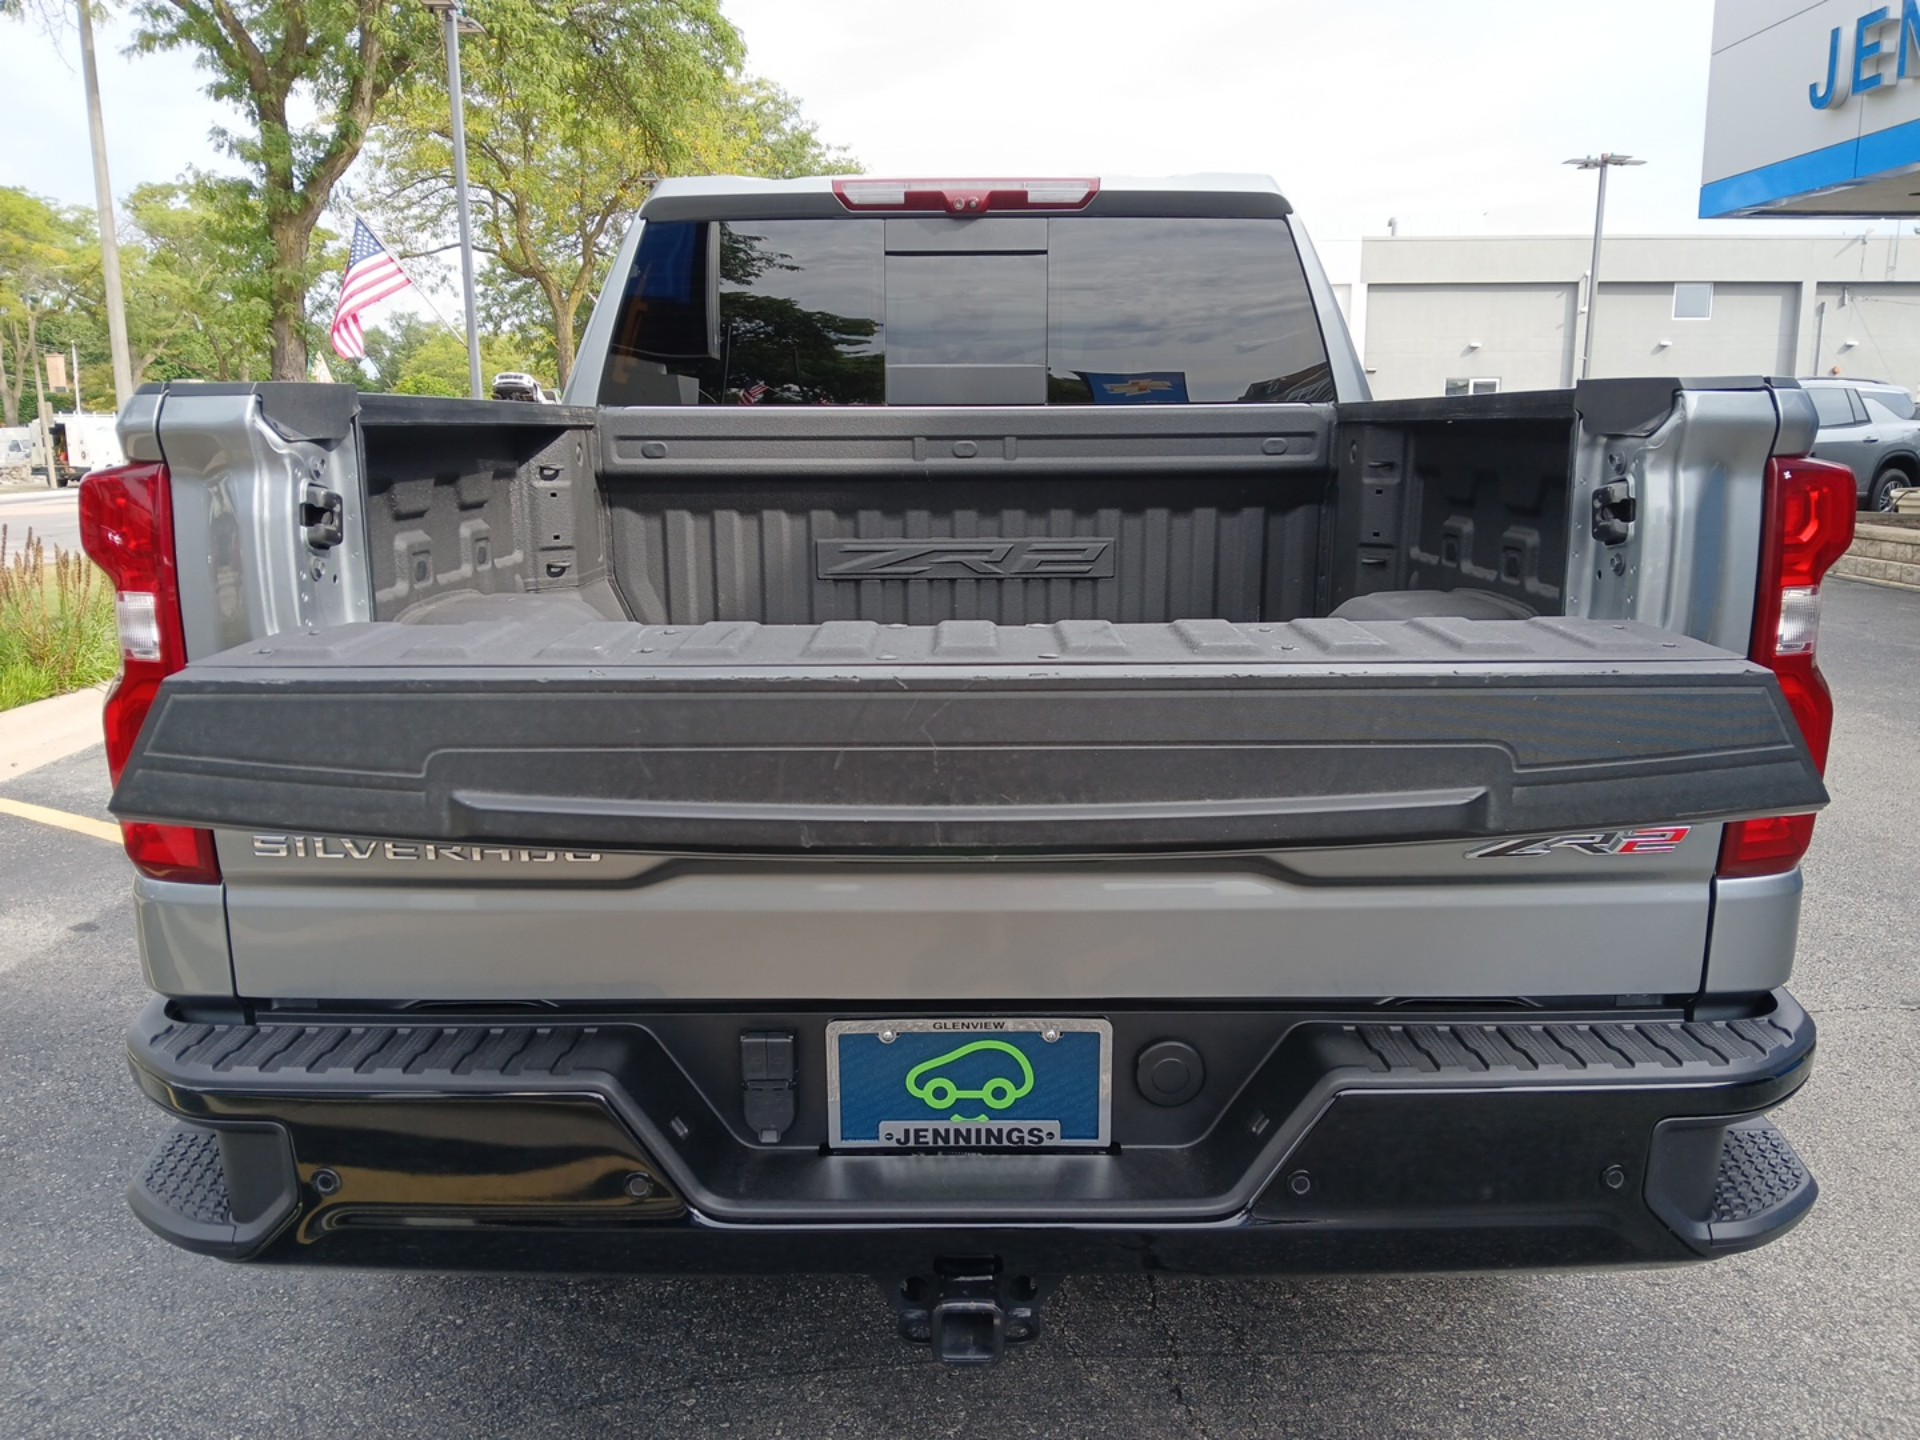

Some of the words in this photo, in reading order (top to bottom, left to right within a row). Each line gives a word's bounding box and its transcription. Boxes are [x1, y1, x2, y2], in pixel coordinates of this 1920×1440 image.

[824, 542, 1109, 575] ZR2
[1463, 826, 1691, 859] ZR2
[932, 1021, 1005, 1030] GLENVIEW
[895, 1127, 1045, 1146] JENNINGS
